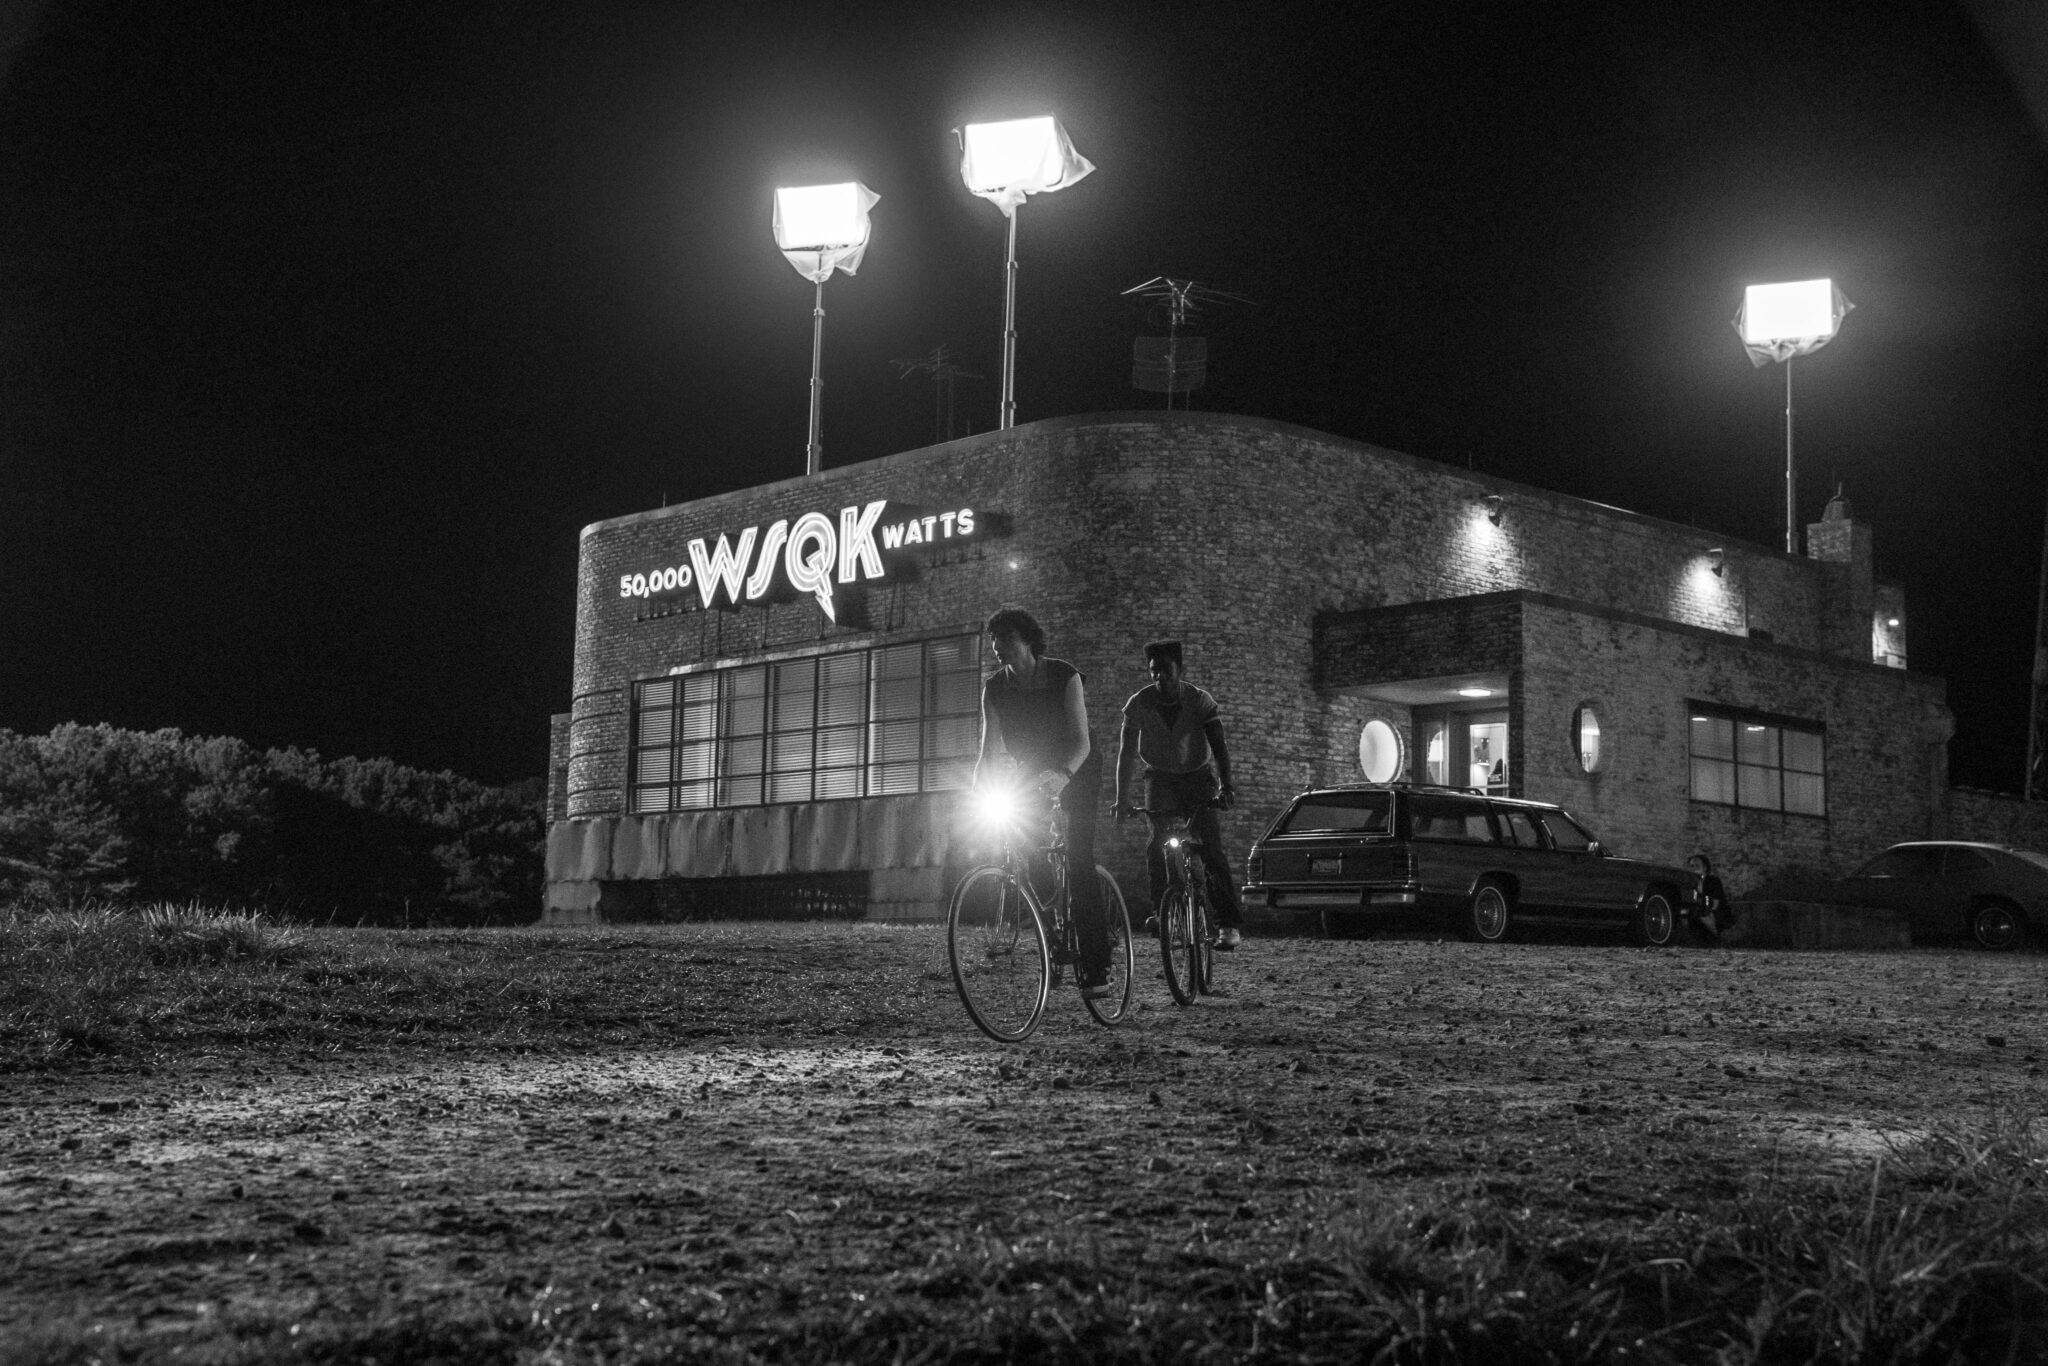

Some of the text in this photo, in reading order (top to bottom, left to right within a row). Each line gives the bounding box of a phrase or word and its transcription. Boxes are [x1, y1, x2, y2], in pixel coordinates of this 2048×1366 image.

[620, 500, 975, 623] 50,000 WSQK WATTS
